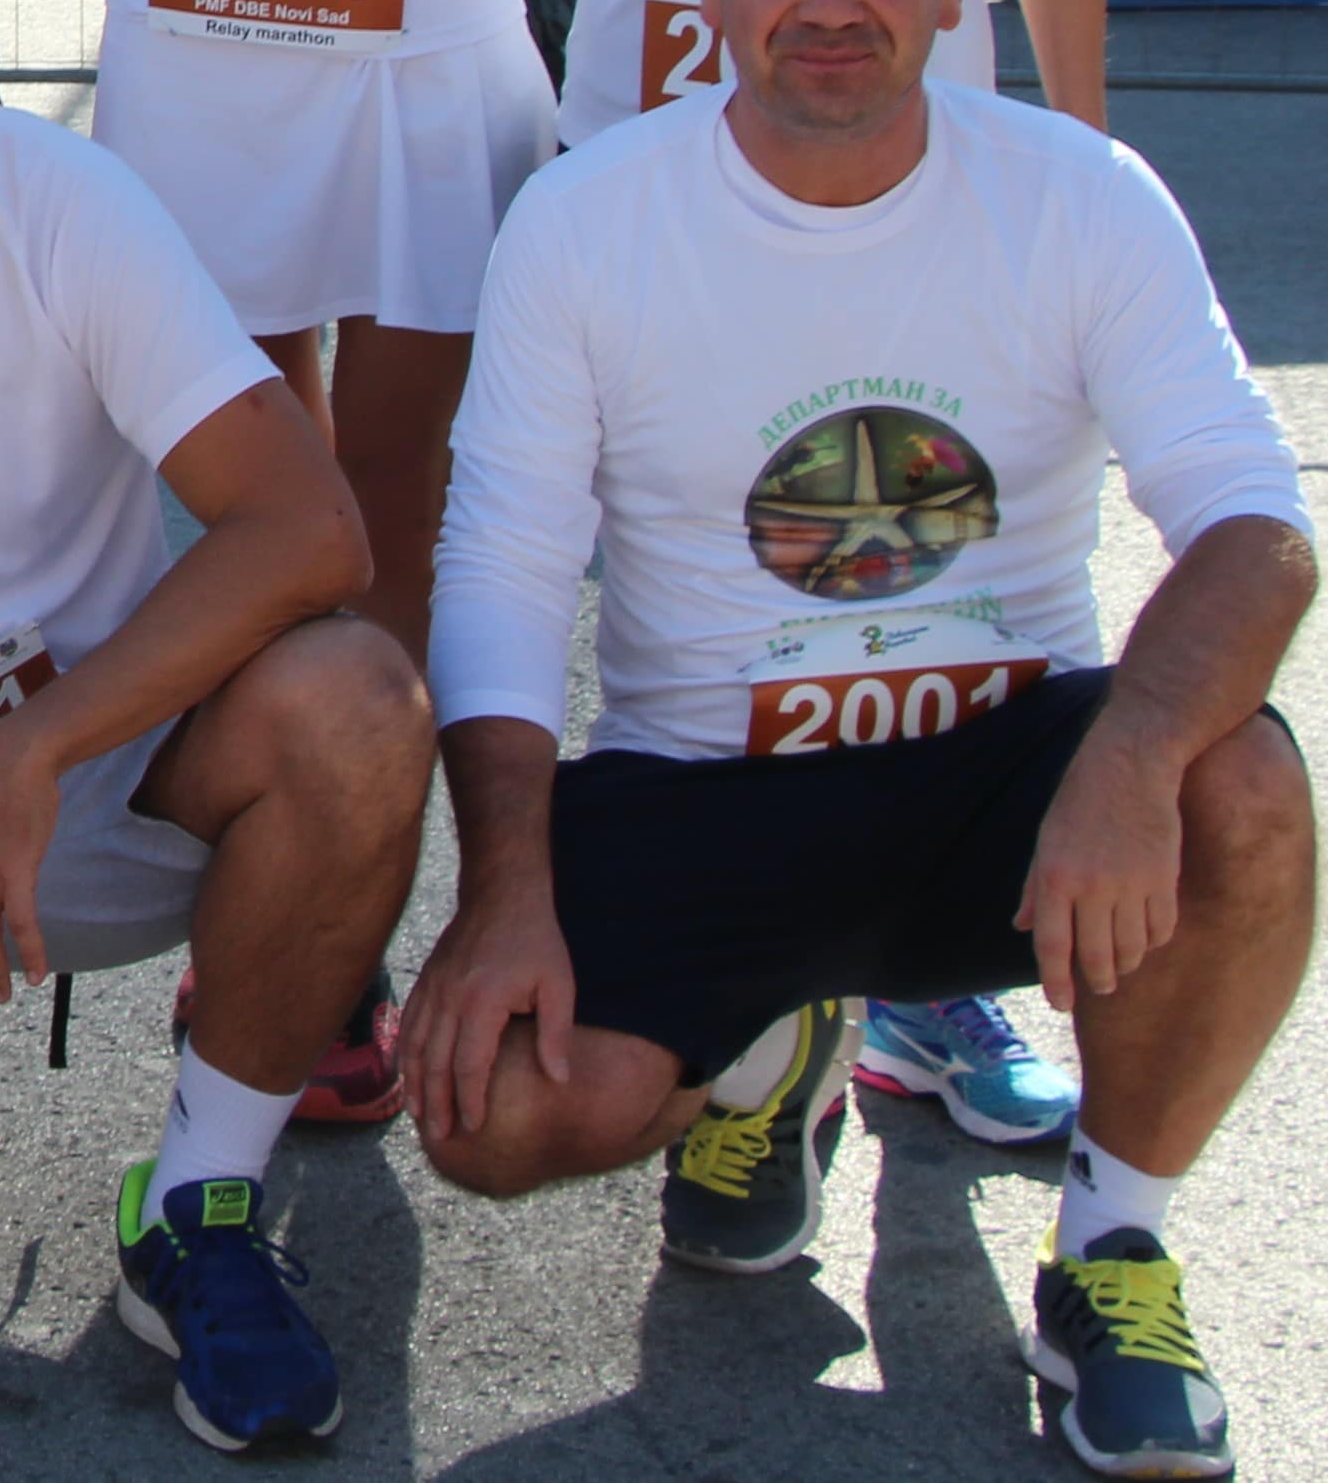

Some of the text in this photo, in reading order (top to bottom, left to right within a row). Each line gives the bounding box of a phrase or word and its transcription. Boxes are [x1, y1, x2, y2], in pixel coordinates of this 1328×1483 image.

[234, 0, 270, 18] DBE
[274, 3, 312, 23] Novi
[317, 6, 351, 26] Sad
[206, 19, 335, 47] Relay marathon
[757, 376, 963, 451] ДЕПАРТМАН ЗА
